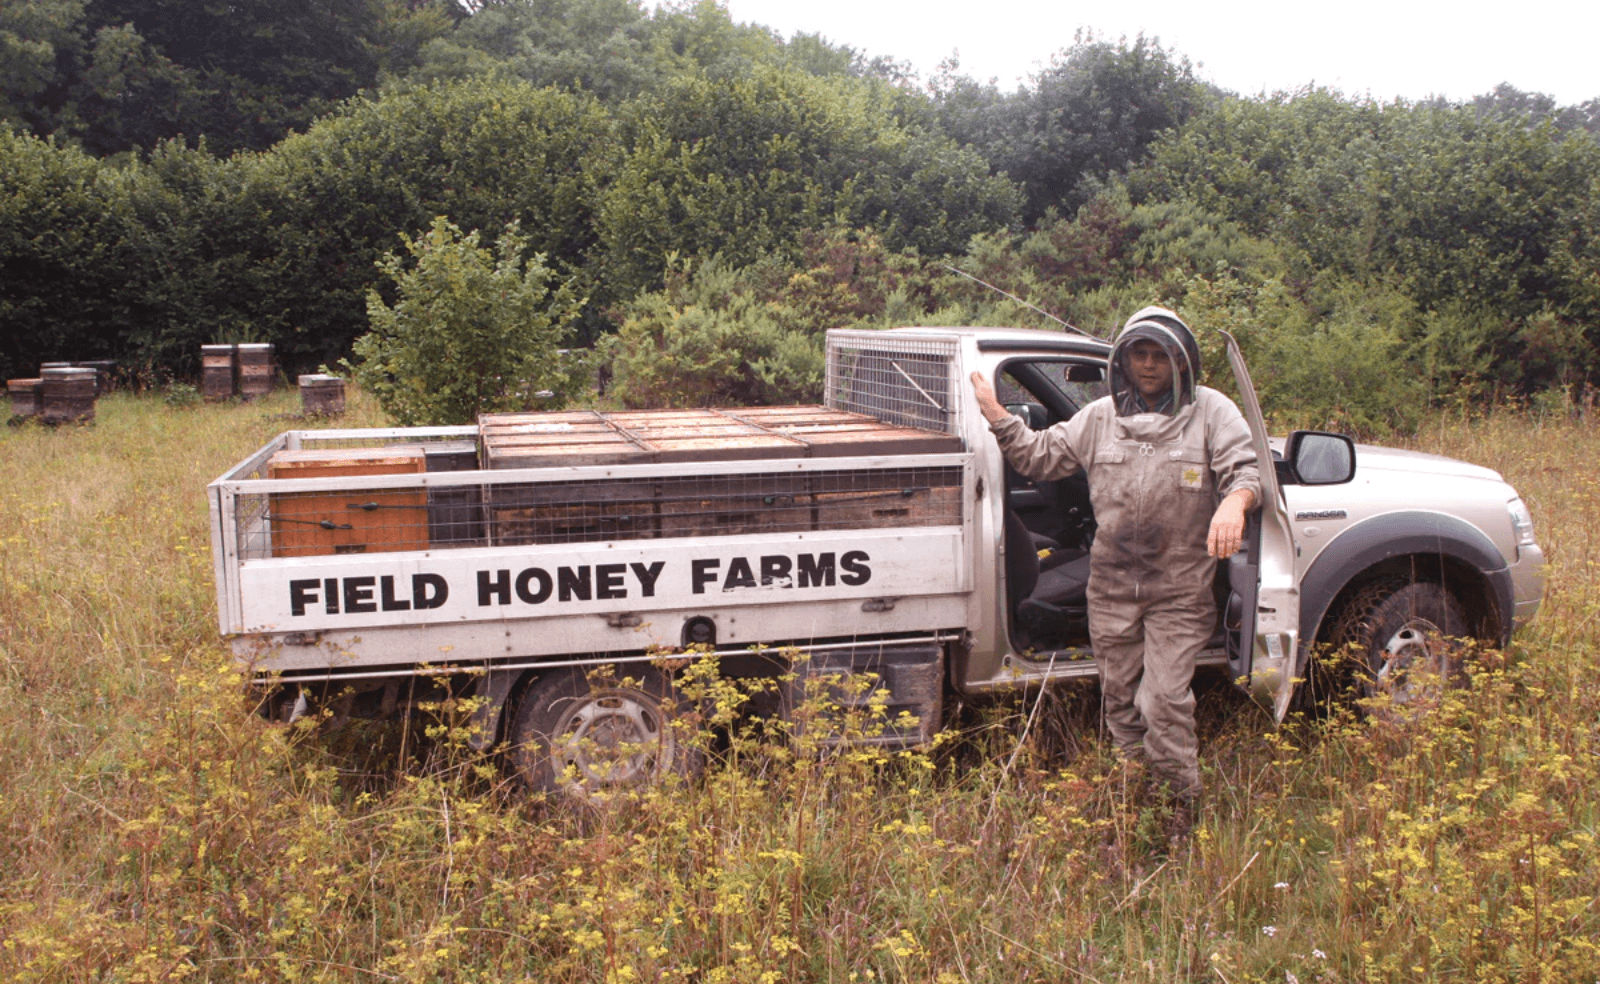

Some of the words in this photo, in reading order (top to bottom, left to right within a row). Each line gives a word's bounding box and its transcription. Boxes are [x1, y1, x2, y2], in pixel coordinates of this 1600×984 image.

[289, 573, 449, 617] FIELD
[478, 561, 666, 607] HONEY
[691, 550, 872, 594] FARMS
